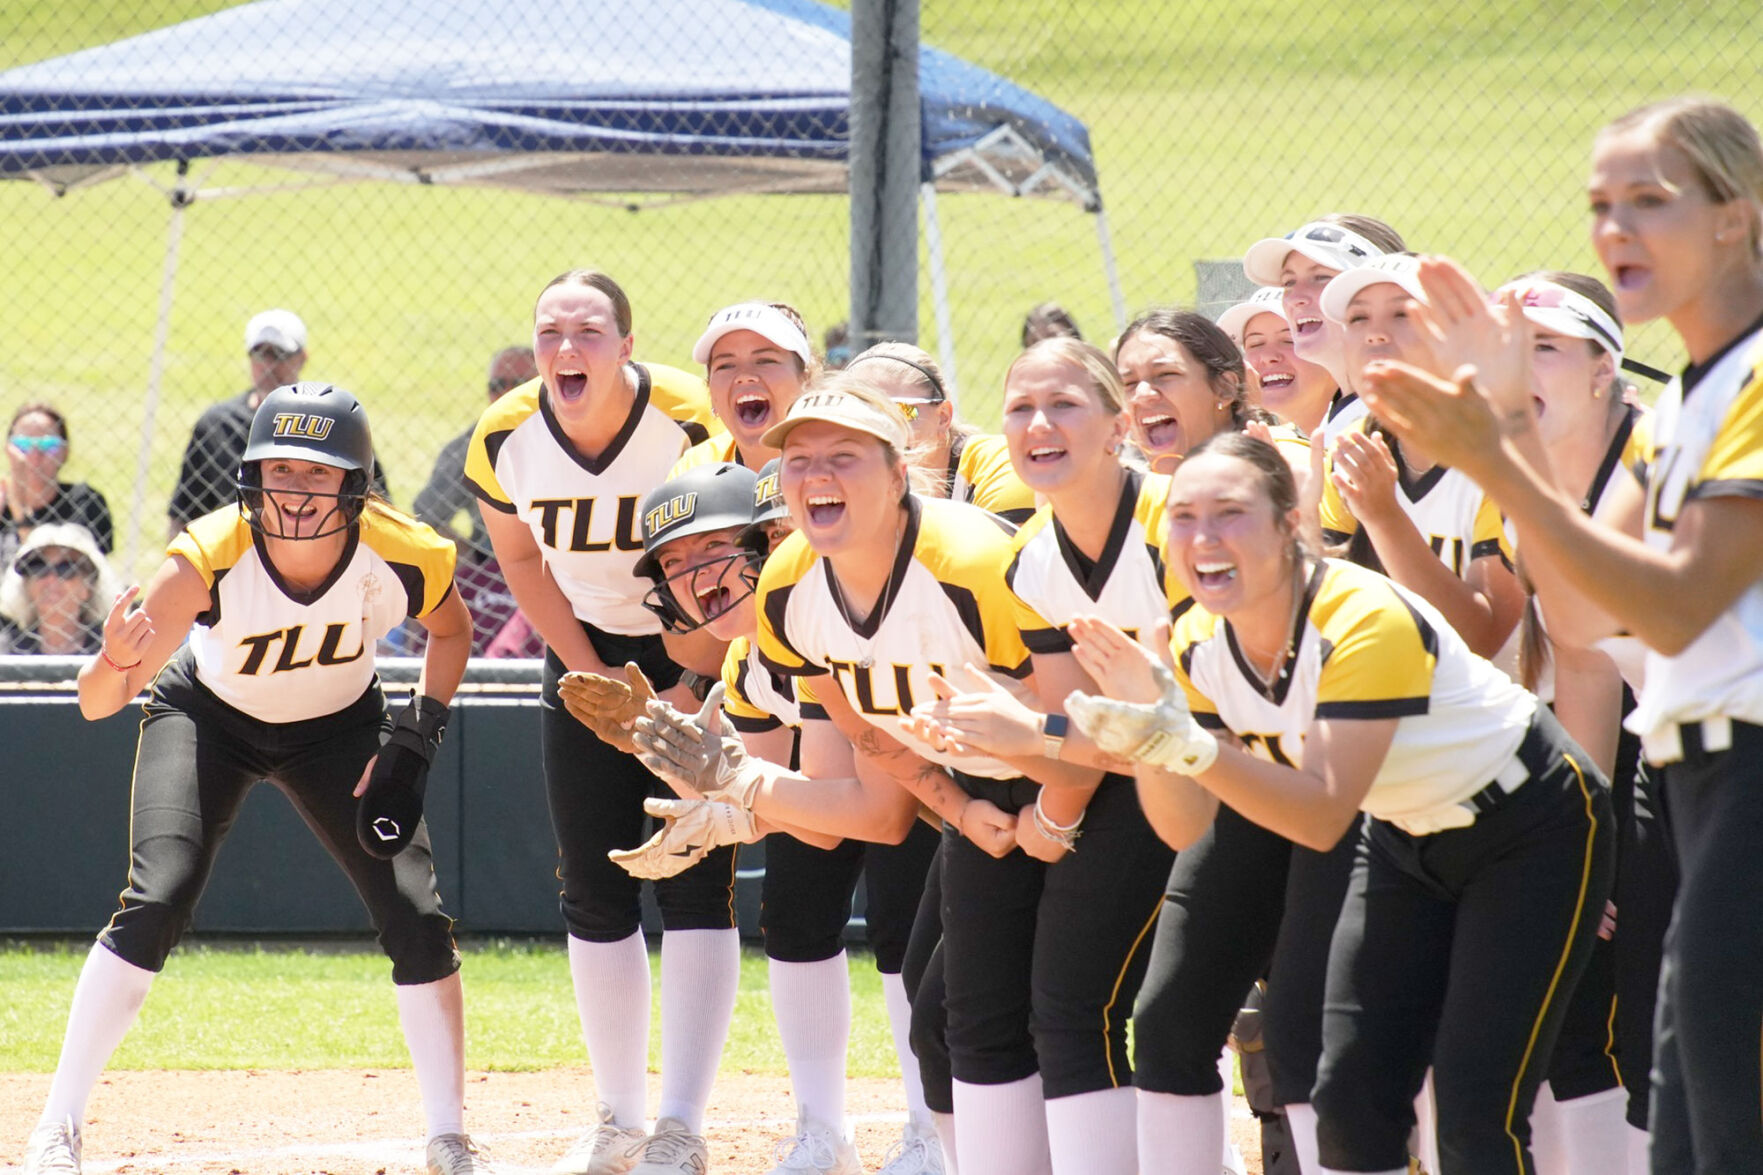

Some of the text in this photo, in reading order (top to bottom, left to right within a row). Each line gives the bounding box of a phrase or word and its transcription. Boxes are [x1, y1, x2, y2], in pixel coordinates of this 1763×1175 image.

[273, 413, 335, 441] TLU
[754, 472, 784, 507] TL
[644, 491, 698, 538] TLU
[235, 621, 365, 676] TLU
